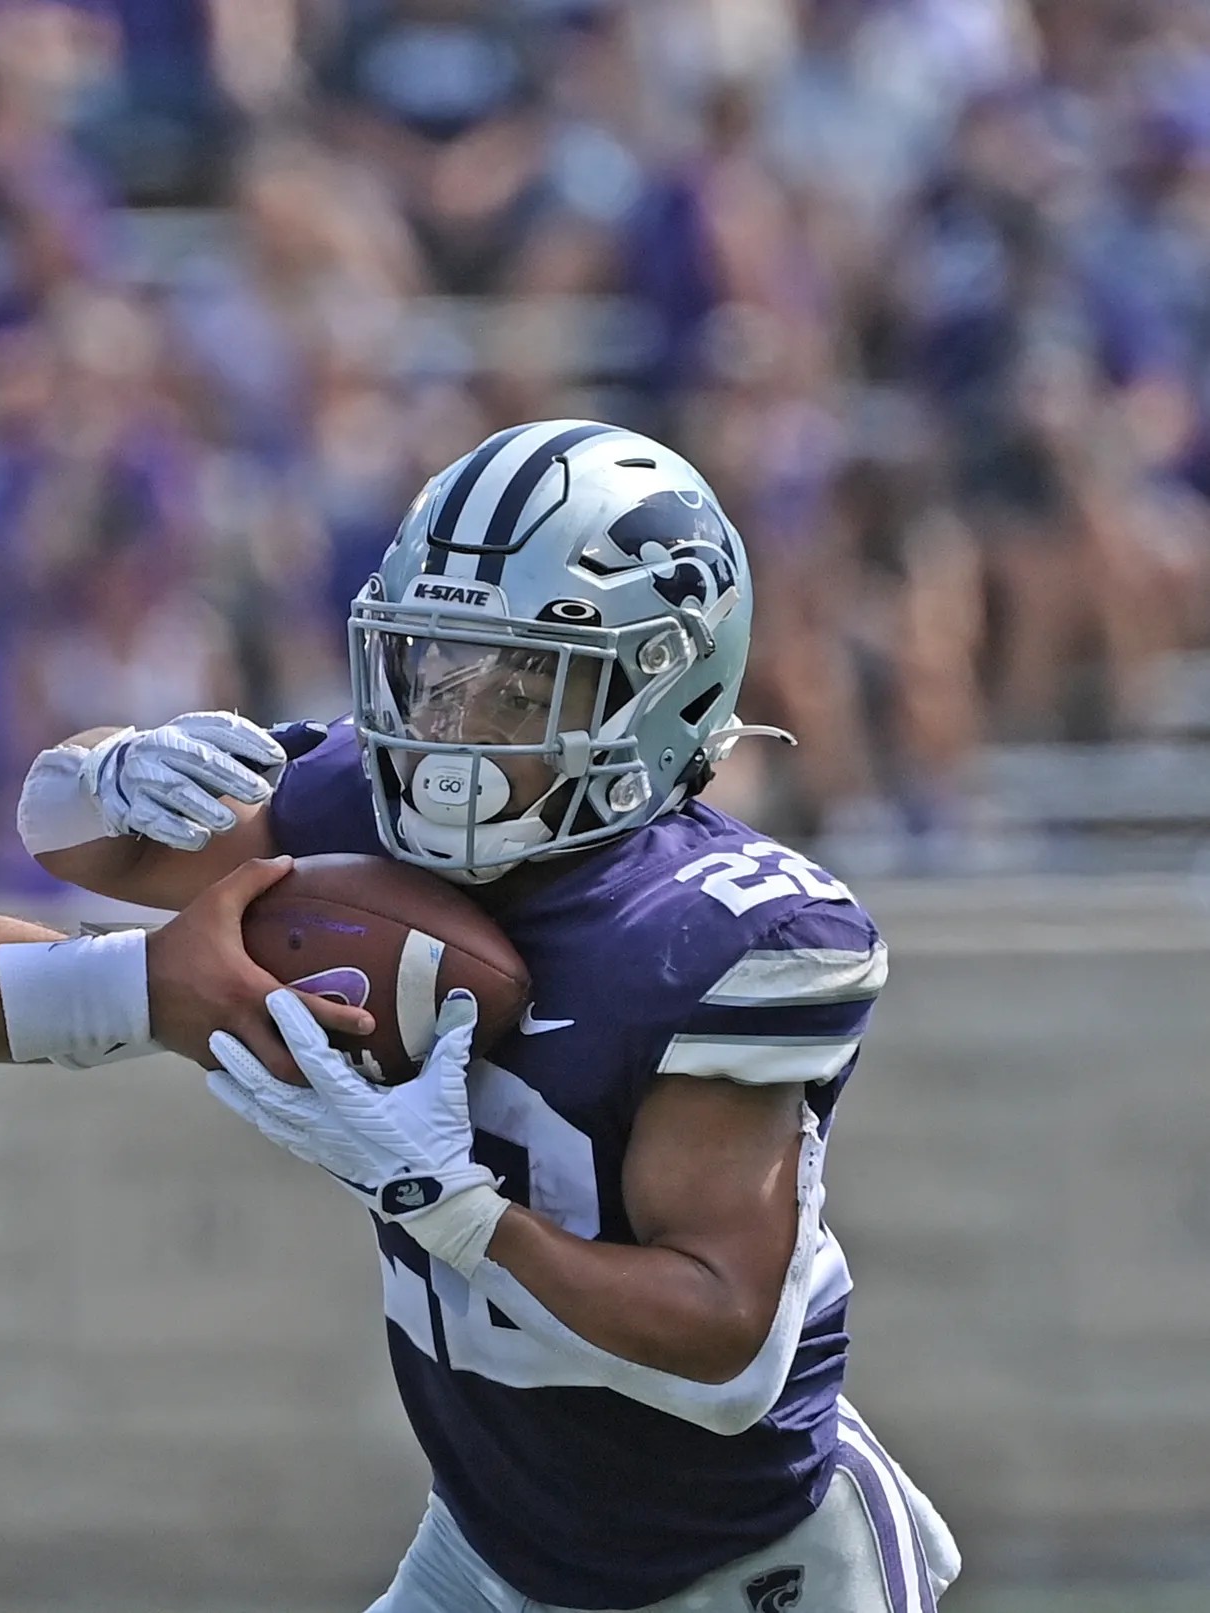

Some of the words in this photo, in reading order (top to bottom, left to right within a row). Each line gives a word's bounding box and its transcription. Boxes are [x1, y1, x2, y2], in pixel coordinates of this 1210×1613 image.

[414, 583, 490, 606] K-STATE
[439, 779, 462, 793] GO
[674, 842, 860, 917] 22
